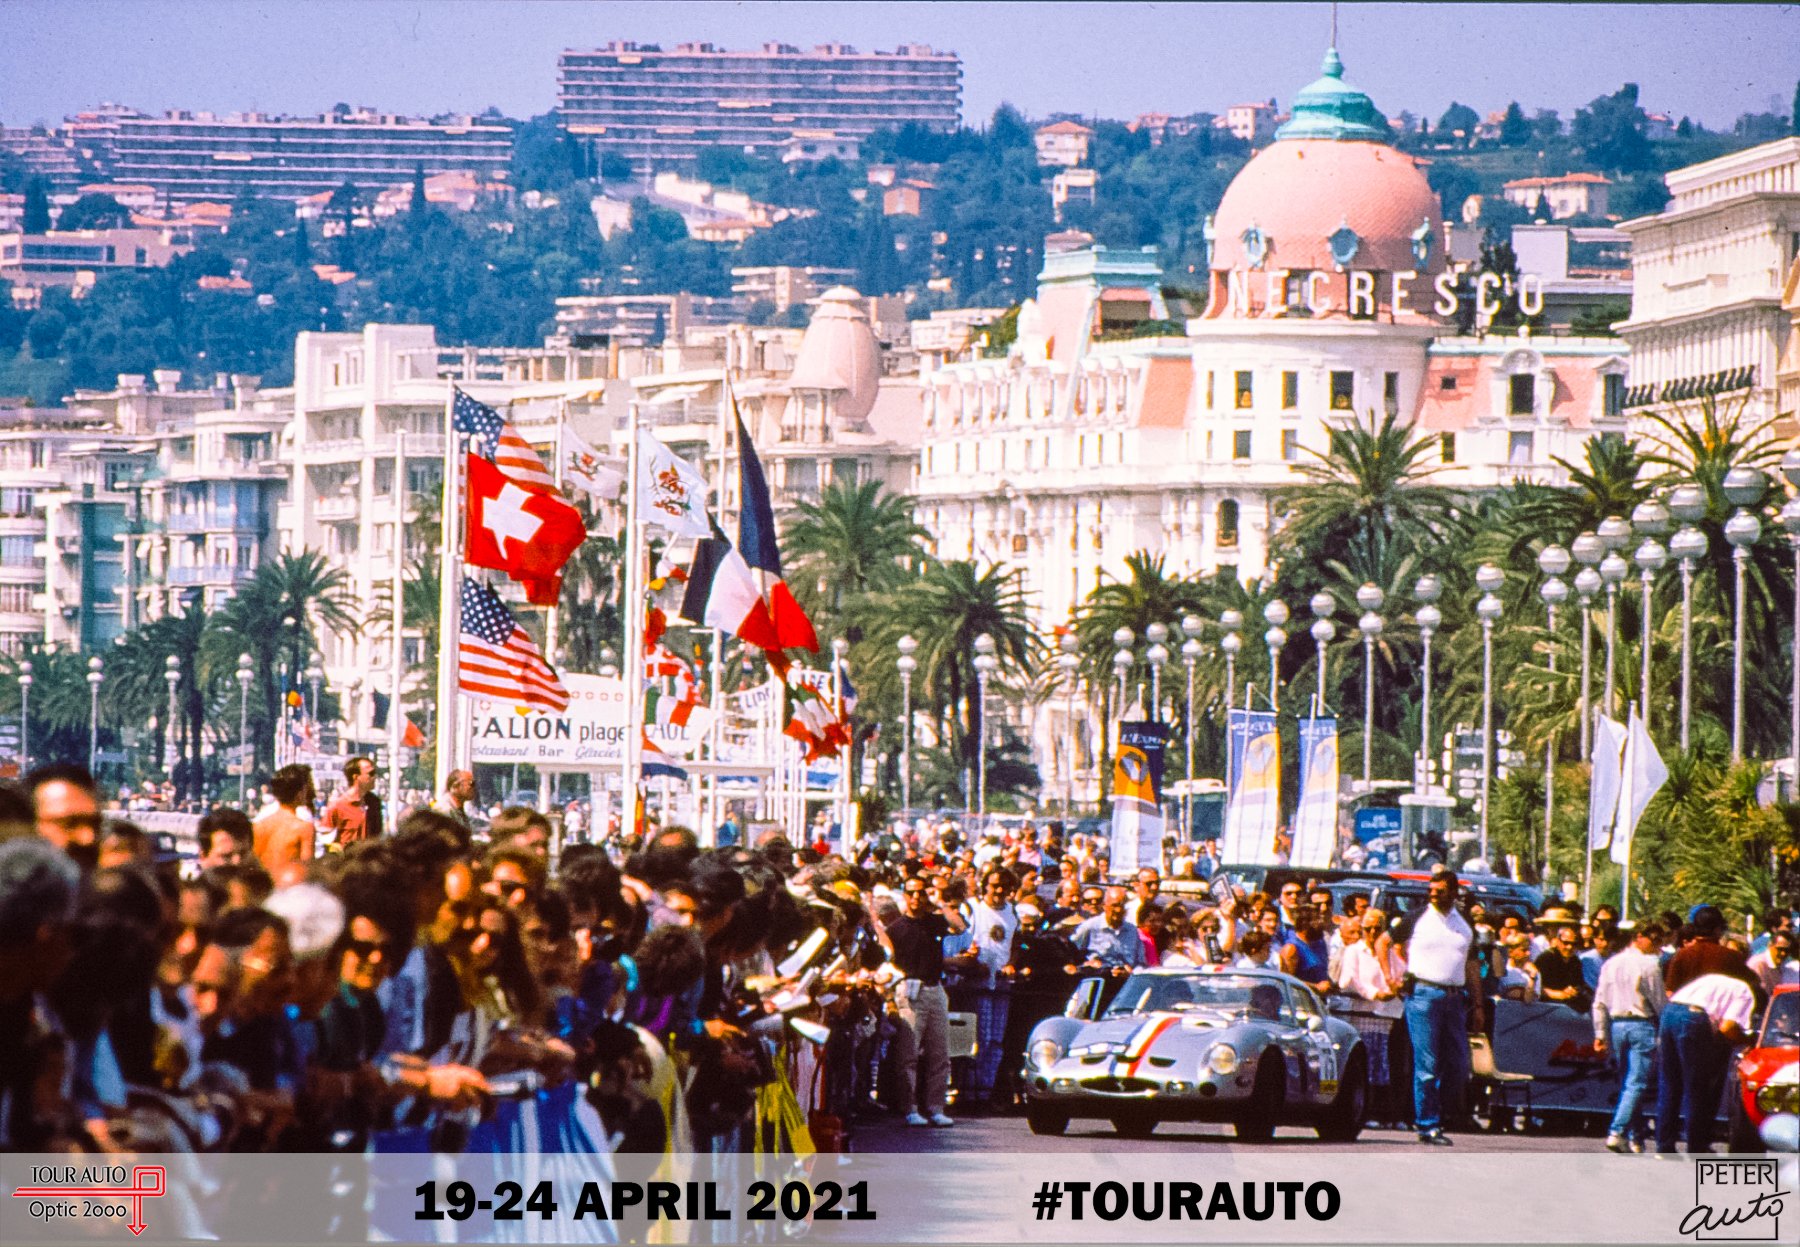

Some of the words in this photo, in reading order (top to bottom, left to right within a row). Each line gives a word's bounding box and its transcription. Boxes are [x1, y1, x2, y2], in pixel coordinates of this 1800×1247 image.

[1227, 269, 1544, 317] NEGRESCO
[579, 721, 625, 746] plage
[538, 745, 564, 757] Bar
